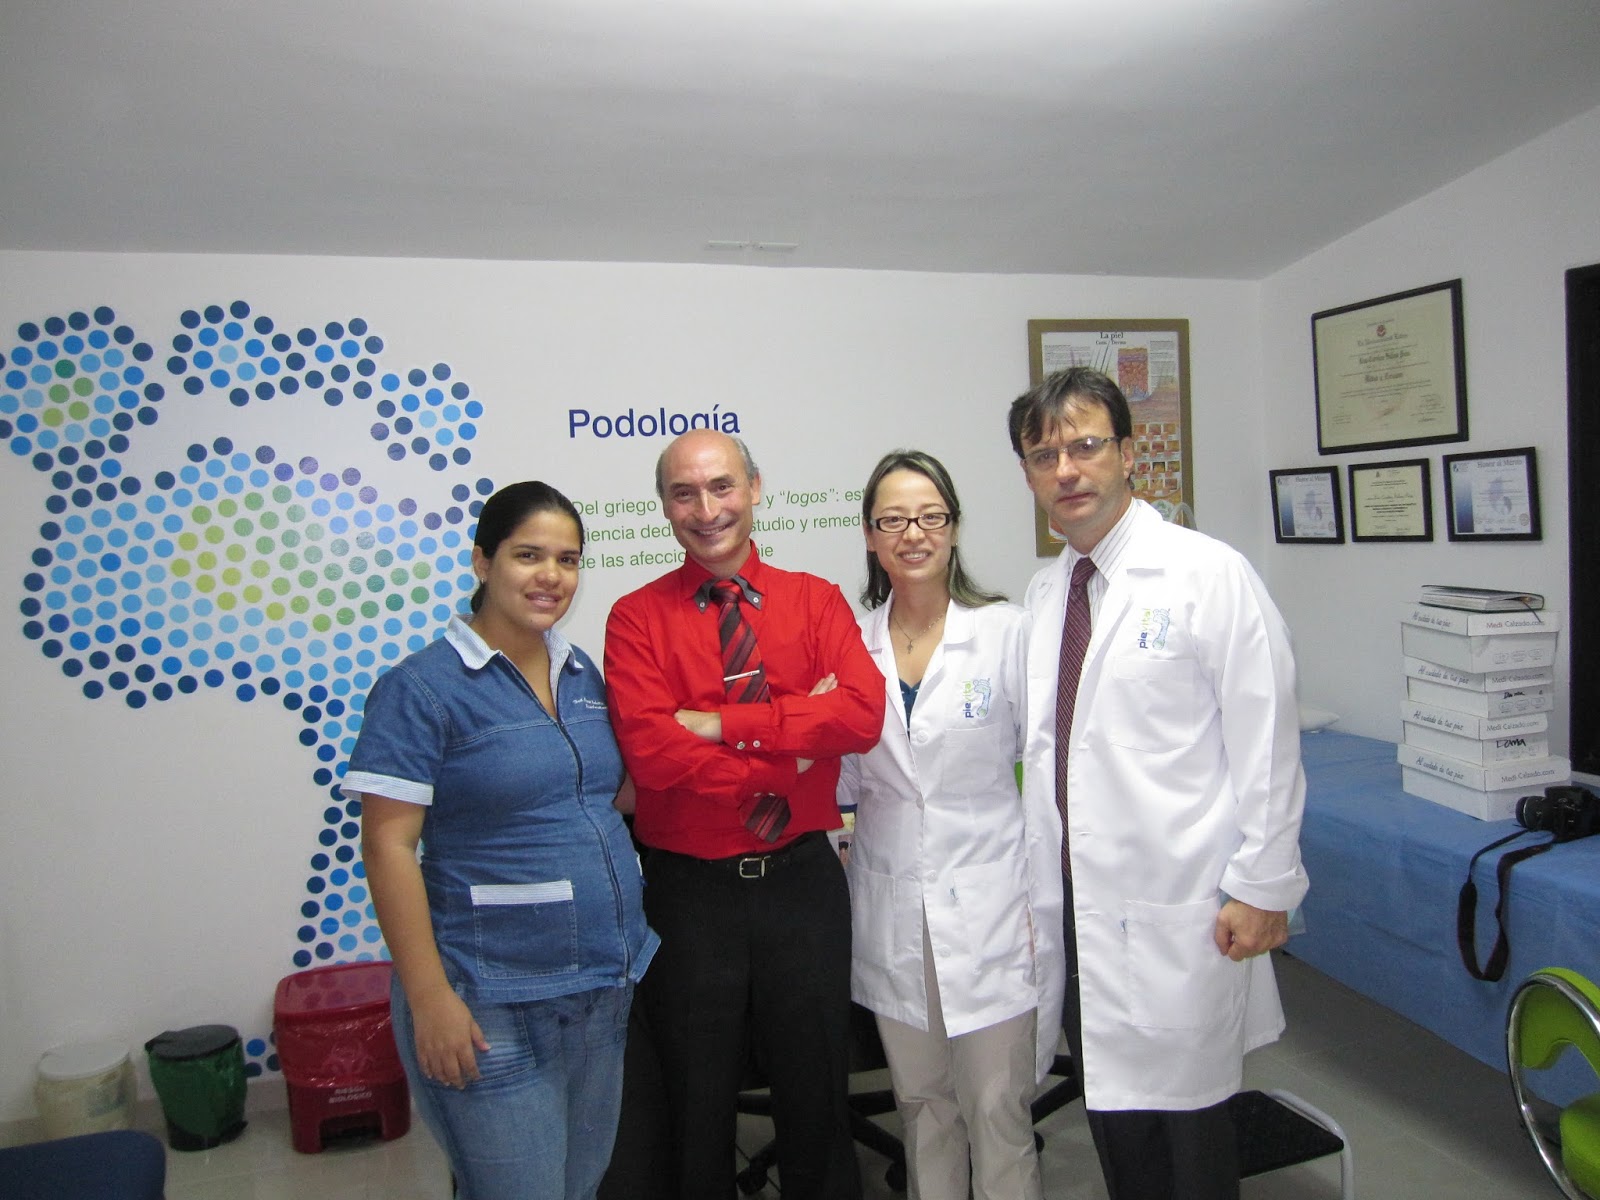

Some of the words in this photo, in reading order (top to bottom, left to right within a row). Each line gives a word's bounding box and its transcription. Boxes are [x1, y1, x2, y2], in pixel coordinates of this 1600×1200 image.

[1110, 331, 1124, 341] piel
[568, 403, 741, 439] Podología
[604, 498, 657, 518] griego
[766, 494, 775, 509] y
[750, 516, 795, 532] studio
[800, 518, 808, 533] y
[813, 512, 864, 529] remed
[584, 525, 636, 542] iencia
[601, 553, 625, 568] las
[630, 549, 686, 566] afeccio
[1491, 676, 1507, 684] Medi
[1508, 673, 1545, 683] Calzado.com
[1486, 724, 1502, 732] Medi
[1503, 721, 1540, 730] Calzado.com
[1501, 775, 1517, 783] Medi
[1518, 769, 1556, 780] Calzado.com
